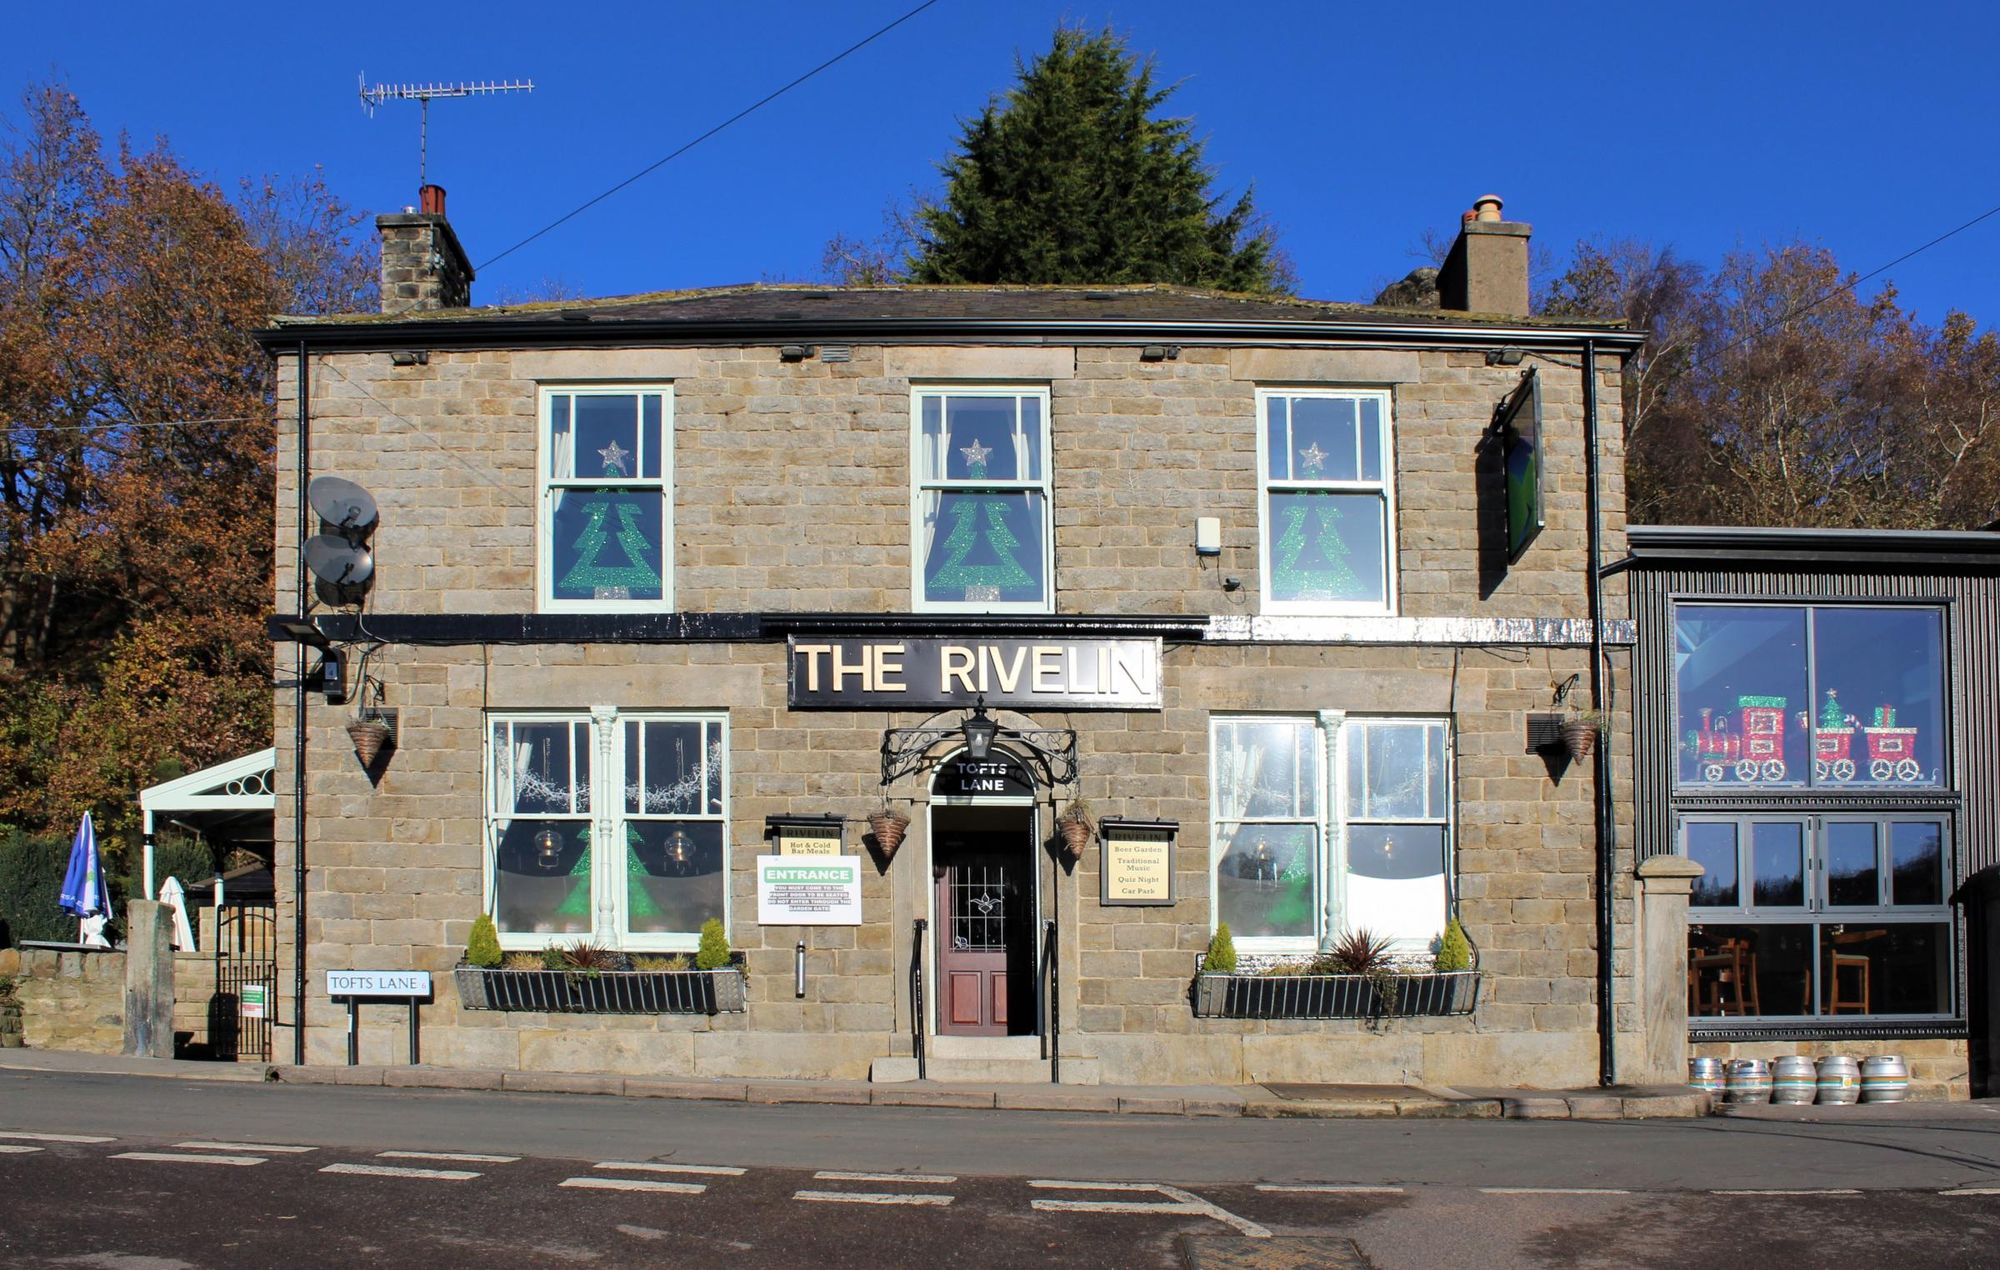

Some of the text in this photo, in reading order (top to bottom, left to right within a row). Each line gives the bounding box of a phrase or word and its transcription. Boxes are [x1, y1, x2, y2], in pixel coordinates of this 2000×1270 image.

[795, 644, 1151, 695] THE RIVELIN
[957, 763, 1008, 775] TOFTS
[961, 780, 1005, 791] LANE
[767, 870, 849, 880] ENTRANCE
[330, 976, 373, 989] TOFTS
[379, 977, 417, 989] LANE
